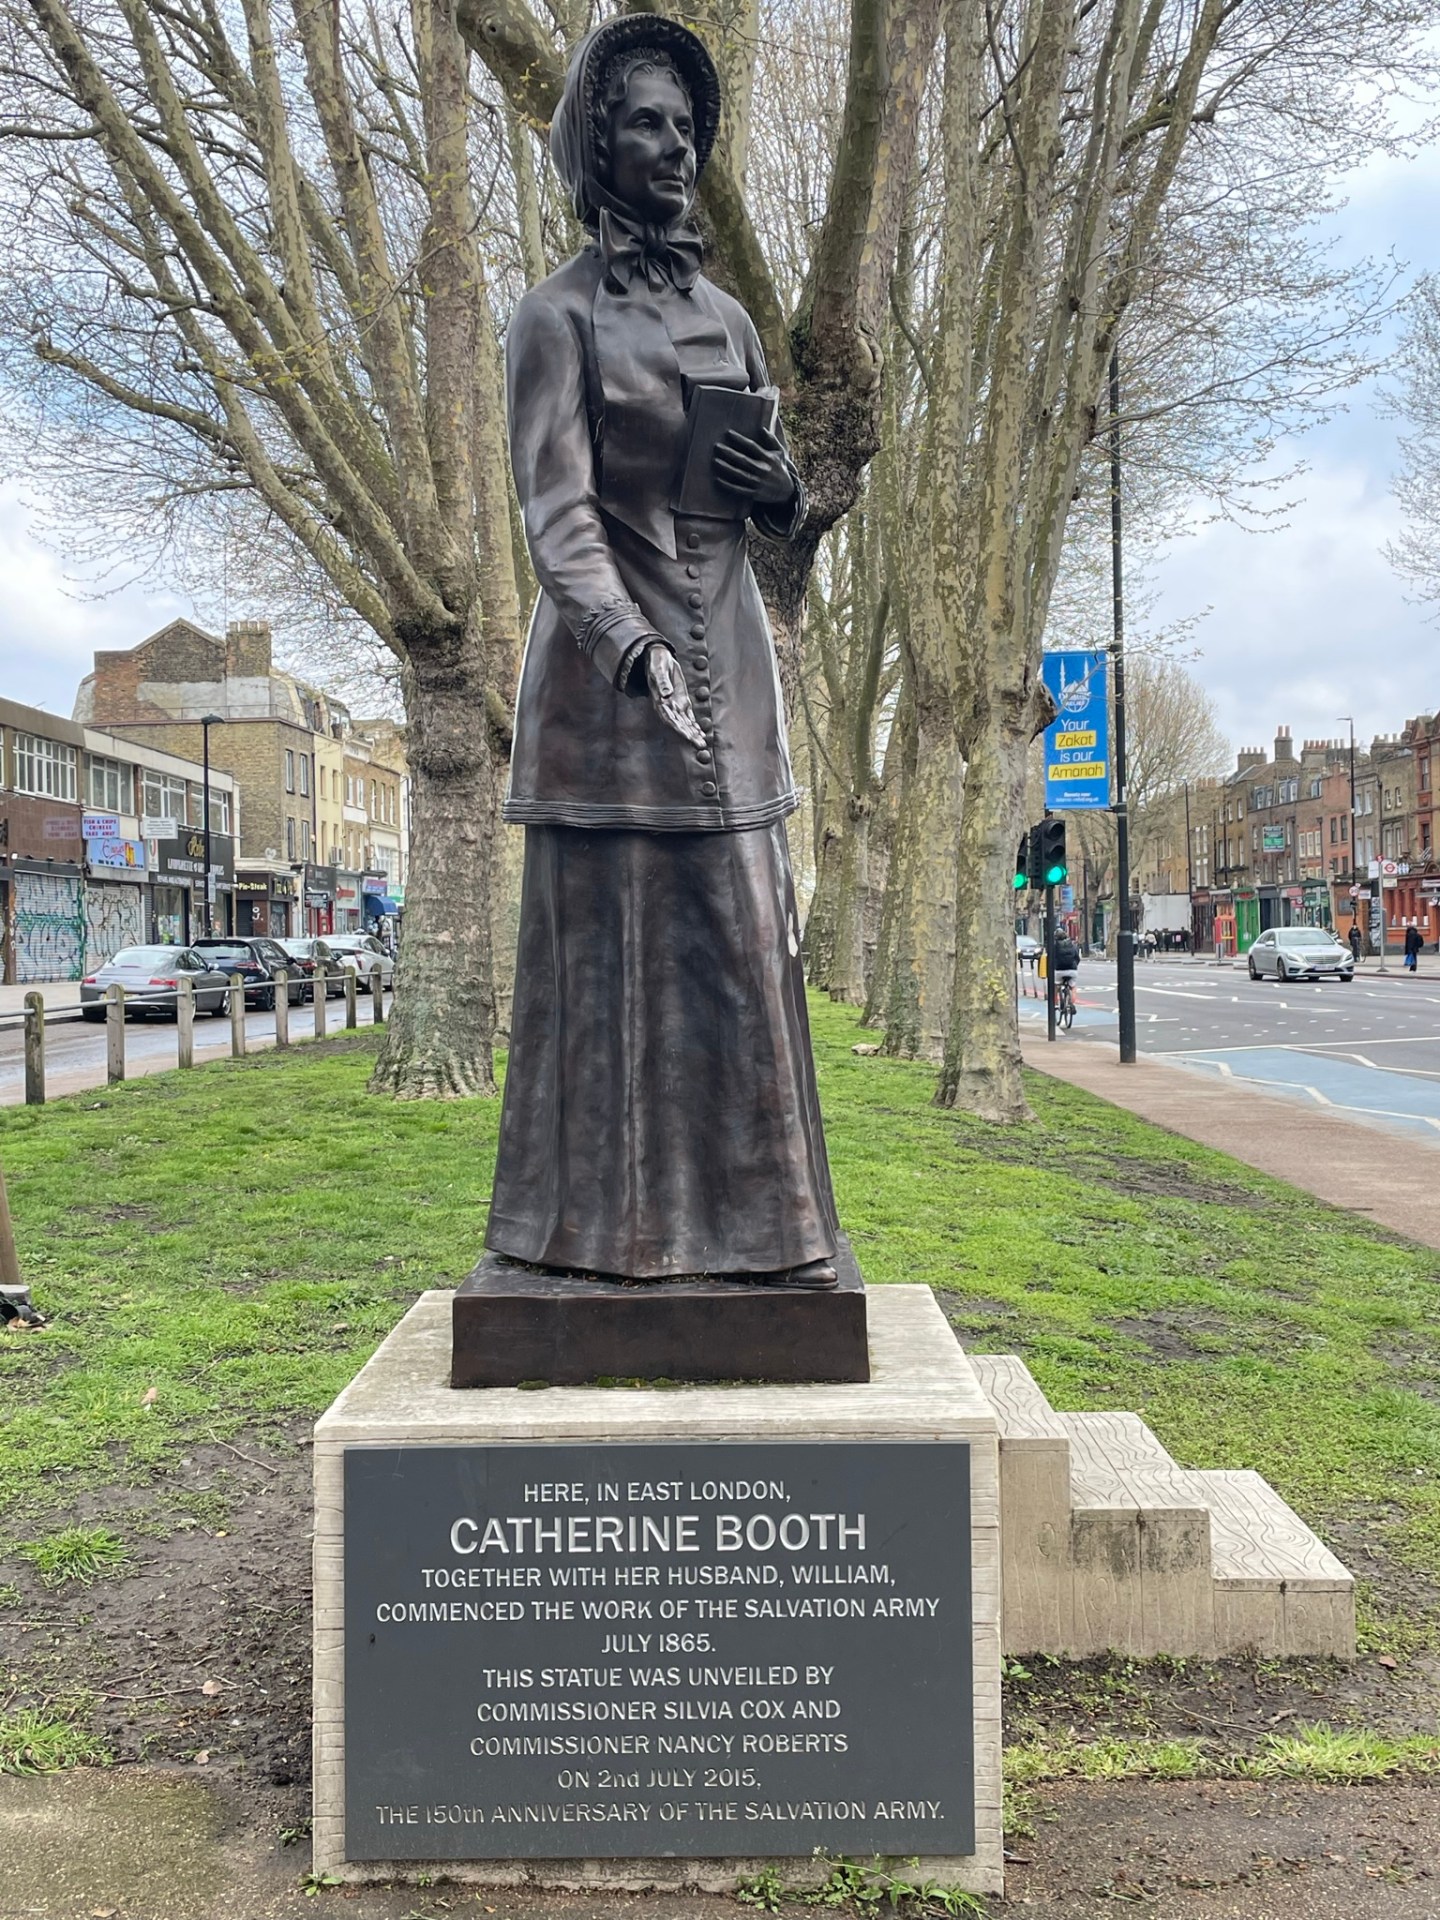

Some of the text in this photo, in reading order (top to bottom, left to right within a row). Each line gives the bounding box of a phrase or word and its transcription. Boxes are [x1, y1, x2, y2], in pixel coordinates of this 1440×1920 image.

[1061, 719, 1090, 731] Your
[1058, 734, 1093, 747] Zakat
[1060, 750, 1094, 762] is our
[1051, 764, 1103, 778] Amanah
[525, 1480, 790, 1505] HERE, IN EAST LONDON,
[450, 1514, 865, 1554] CATHERINE BOOTH
[421, 1565, 895, 1588] TOGETHER WITH HER HUSBAND, WILLIAM,
[377, 1598, 940, 1622] COMMENCED THE WORK OF THE SALVATION ARMY
[602, 1633, 716, 1654] JULY 1865.
[483, 1665, 834, 1688] THIS STATUE WAS UNVEILED BY
[478, 1700, 840, 1721] COMMISSIONER SILVIA COX AND
[470, 1733, 848, 1756] COMMISSIONER NANCY ROBERTS
[558, 1768, 761, 1790] ON 2nd JULY 2015,
[376, 1800, 944, 1824] THE 150th ANNIVERSARY OF THE SALVATION ARMY.
